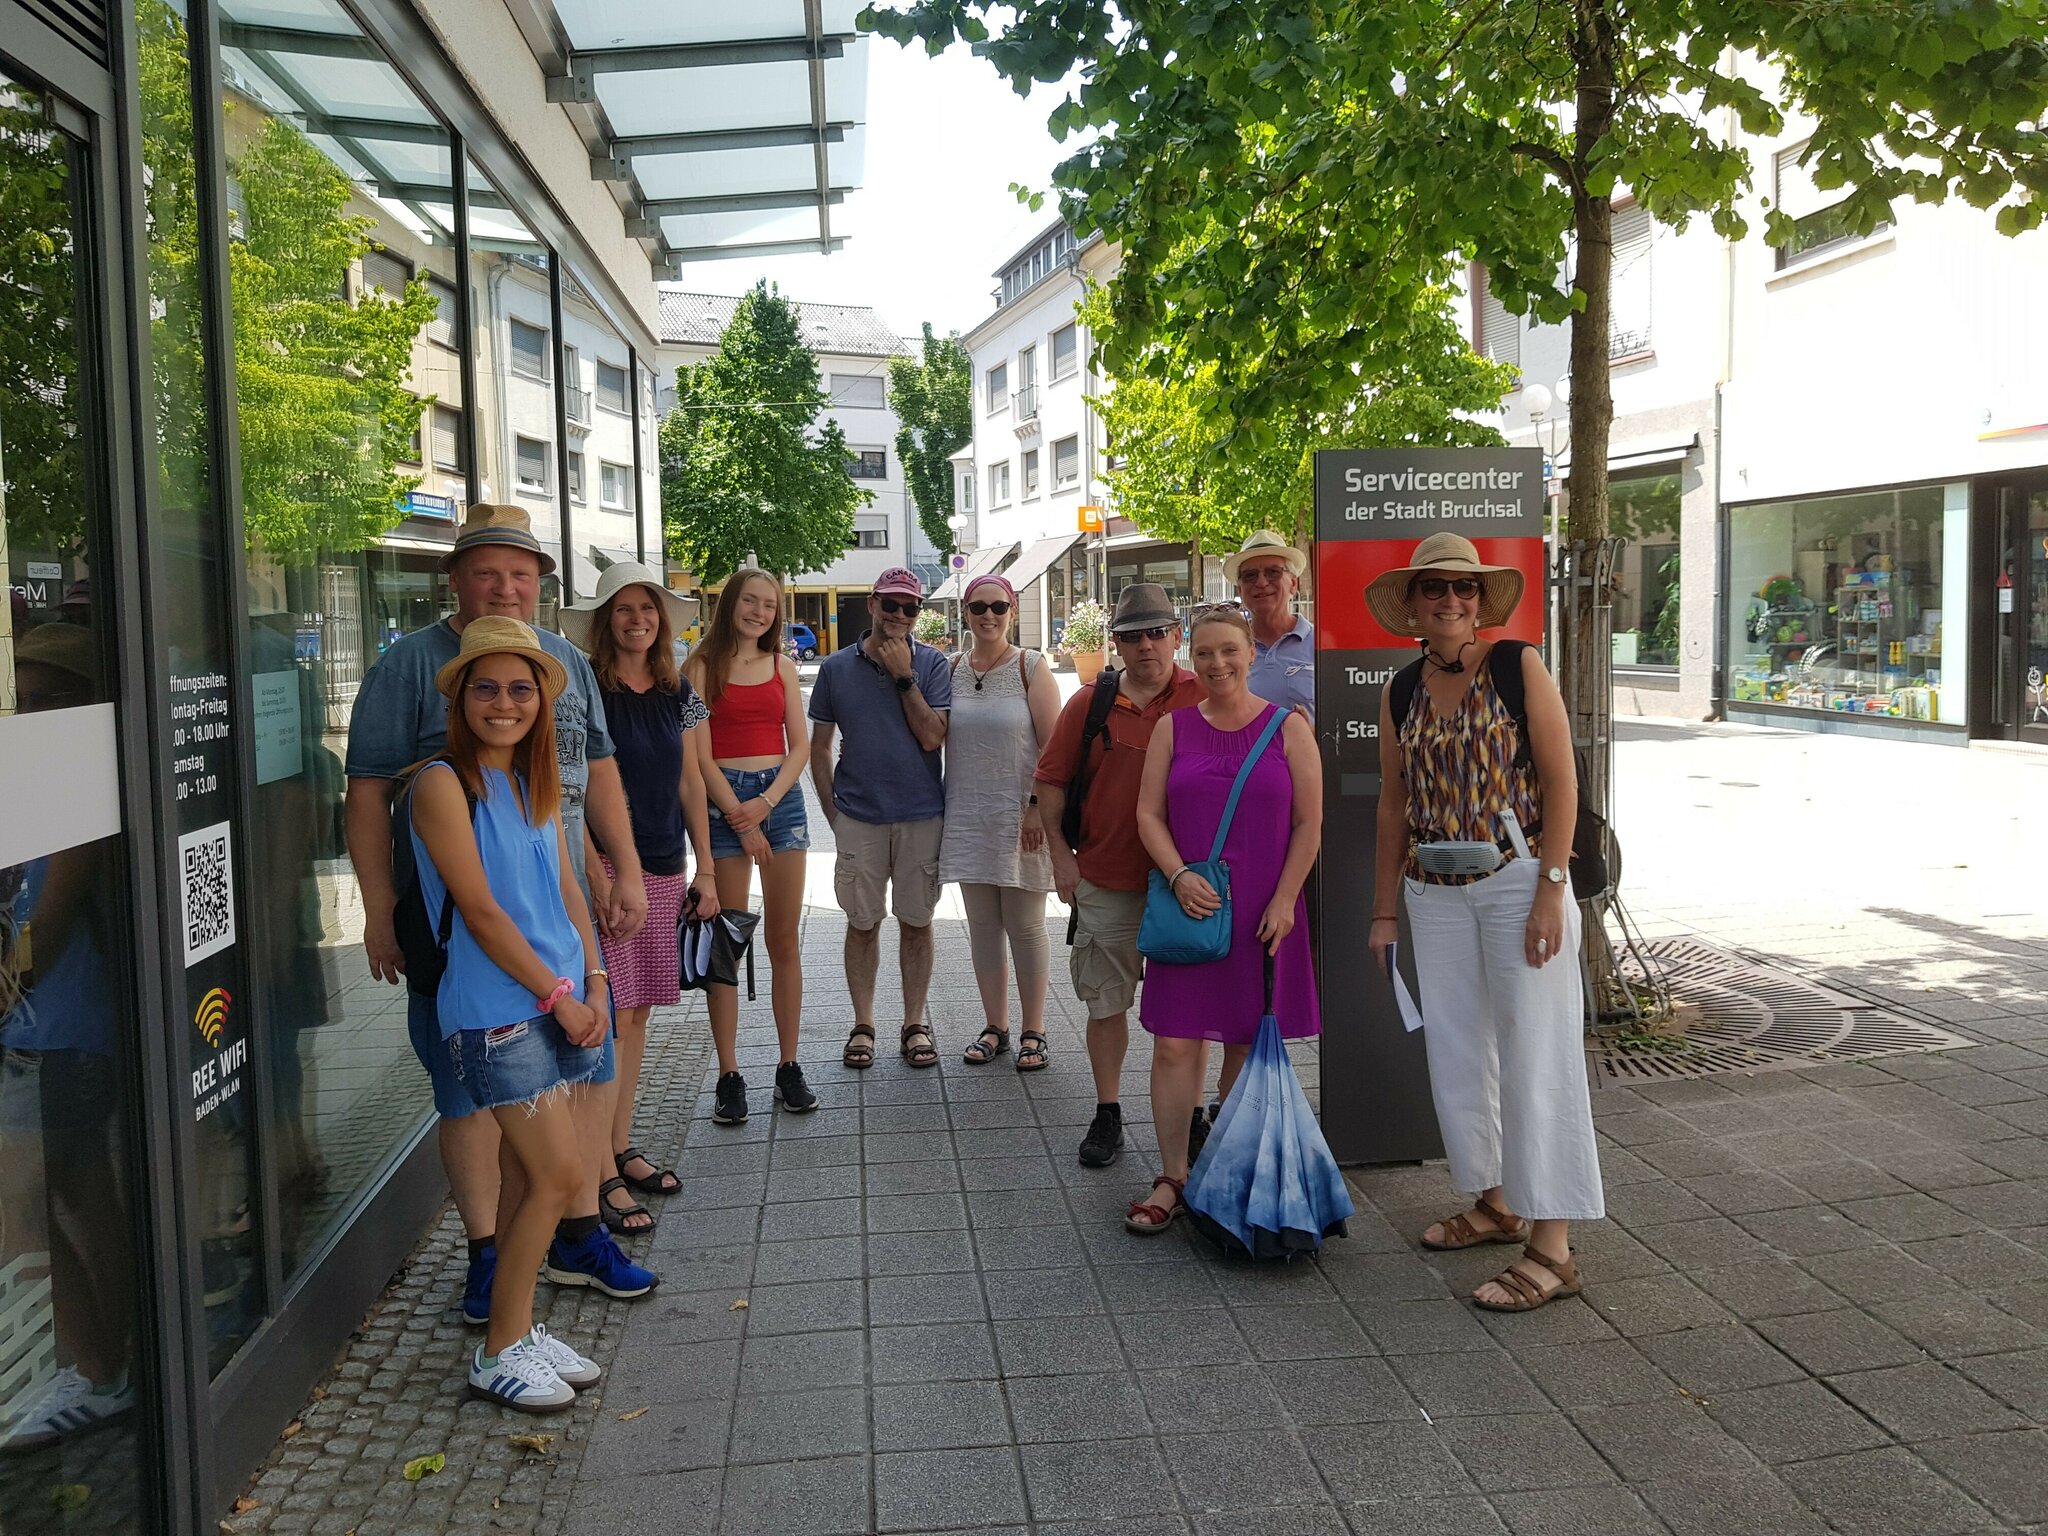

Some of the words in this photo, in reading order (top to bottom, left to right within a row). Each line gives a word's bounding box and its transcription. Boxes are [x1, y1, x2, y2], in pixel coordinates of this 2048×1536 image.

[1344, 467, 1523, 493] Servicecenter
[1345, 501, 1377, 521] der
[1383, 501, 1436, 520] Stadt
[1441, 498, 1523, 519] Bruchsal
[886, 570, 918, 583] CANADA
[1344, 667, 1399, 686] Touri
[171, 697, 228, 721] ontag-Freitag
[193, 723, 214, 743] 18.00
[215, 722, 229, 738] Uhr
[1346, 720, 1379, 739] Sta
[174, 754, 205, 773] amstag
[195, 775, 217, 795] 13.00
[193, 1059, 216, 1098] REE
[220, 1038, 246, 1077] WIFI
[196, 1077, 240, 1121] BADEN-WLAN
